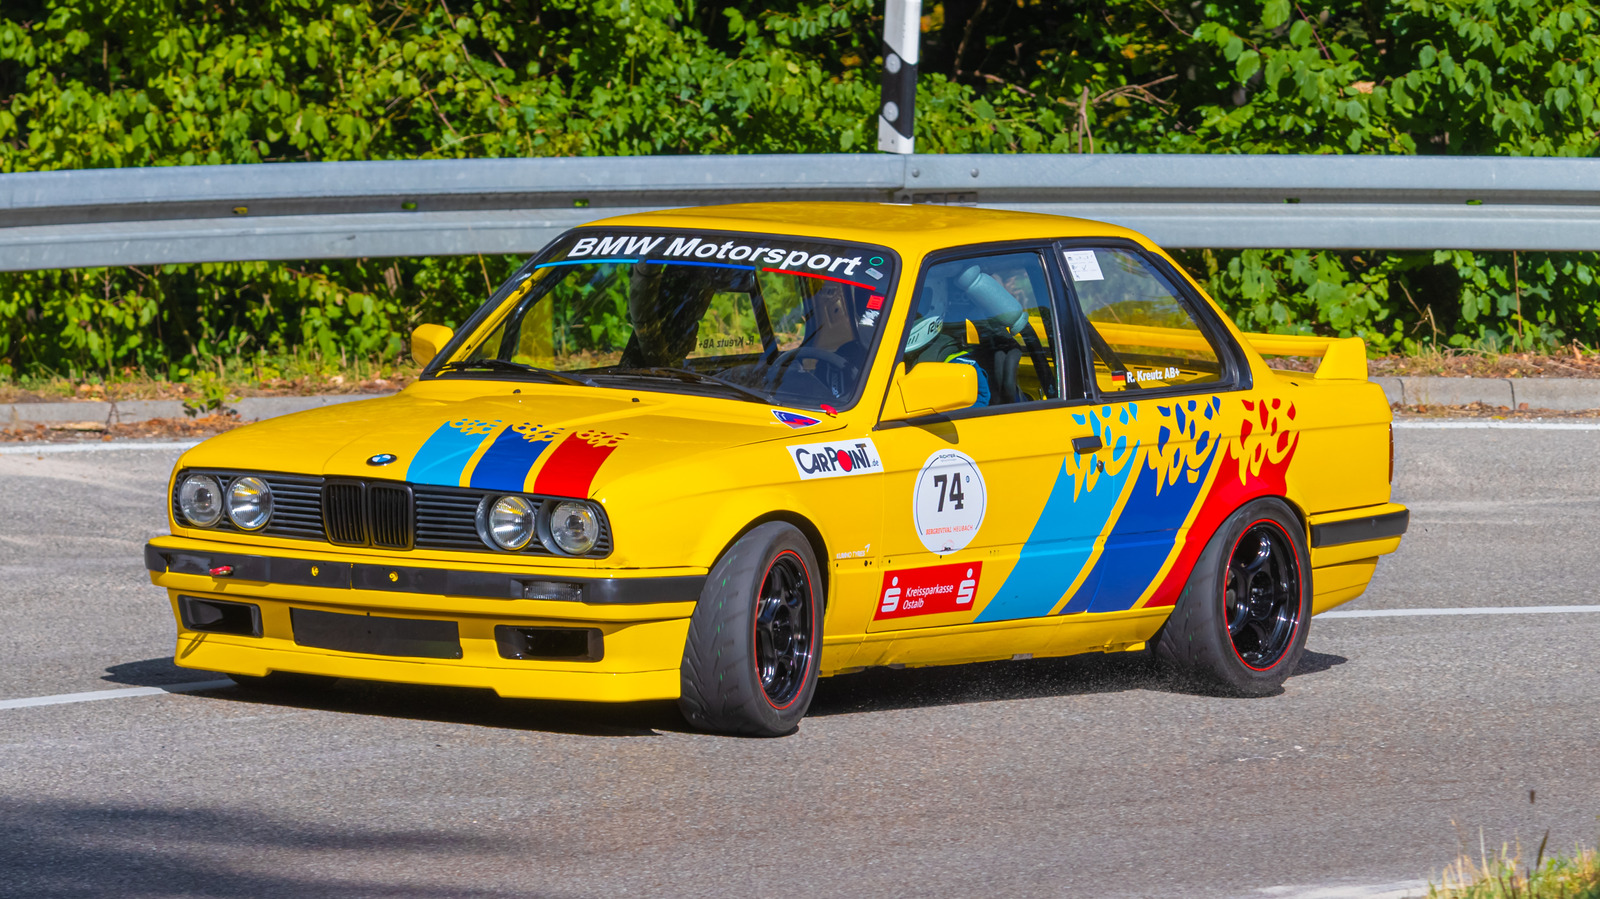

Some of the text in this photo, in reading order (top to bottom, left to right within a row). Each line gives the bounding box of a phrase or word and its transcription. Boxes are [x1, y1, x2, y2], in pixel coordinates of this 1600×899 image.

[567, 236, 665, 257] BMW
[663, 237, 862, 276] Motorsport
[1126, 366, 1180, 383] R. Kreutz AB+
[933, 472, 964, 513] 74
[905, 584, 954, 598] Kreissparkasse
[902, 598, 925, 610] Ostalb
